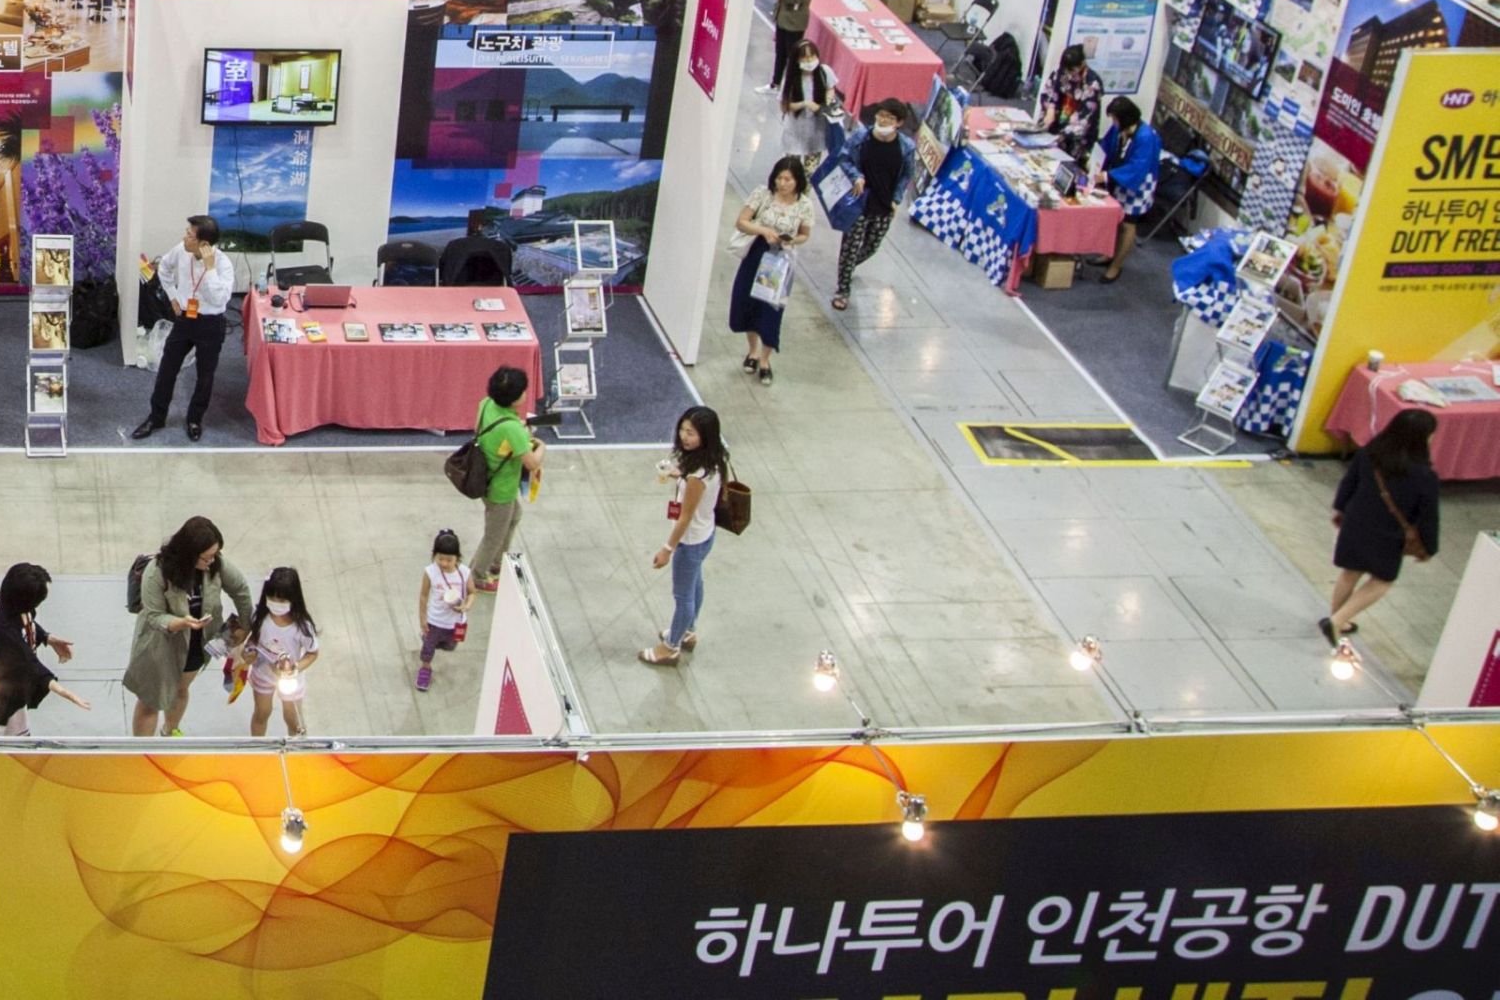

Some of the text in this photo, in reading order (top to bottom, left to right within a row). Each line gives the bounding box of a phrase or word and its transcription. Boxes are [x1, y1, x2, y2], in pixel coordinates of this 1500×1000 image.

[700, 8, 720, 42] JAPAN
[478, 35, 564, 52] 노구치 관광
[1331, 87, 1364, 117] 도미인
[1442, 90, 1473, 106] HNT
[289, 129, 310, 187] 洞爺湖
[1402, 199, 1489, 226] 하나투어
[1390, 228, 1500, 254] DUTY FREE
[695, 901, 1005, 978] 하나투어
[1027, 883, 1328, 965] 인천공항
